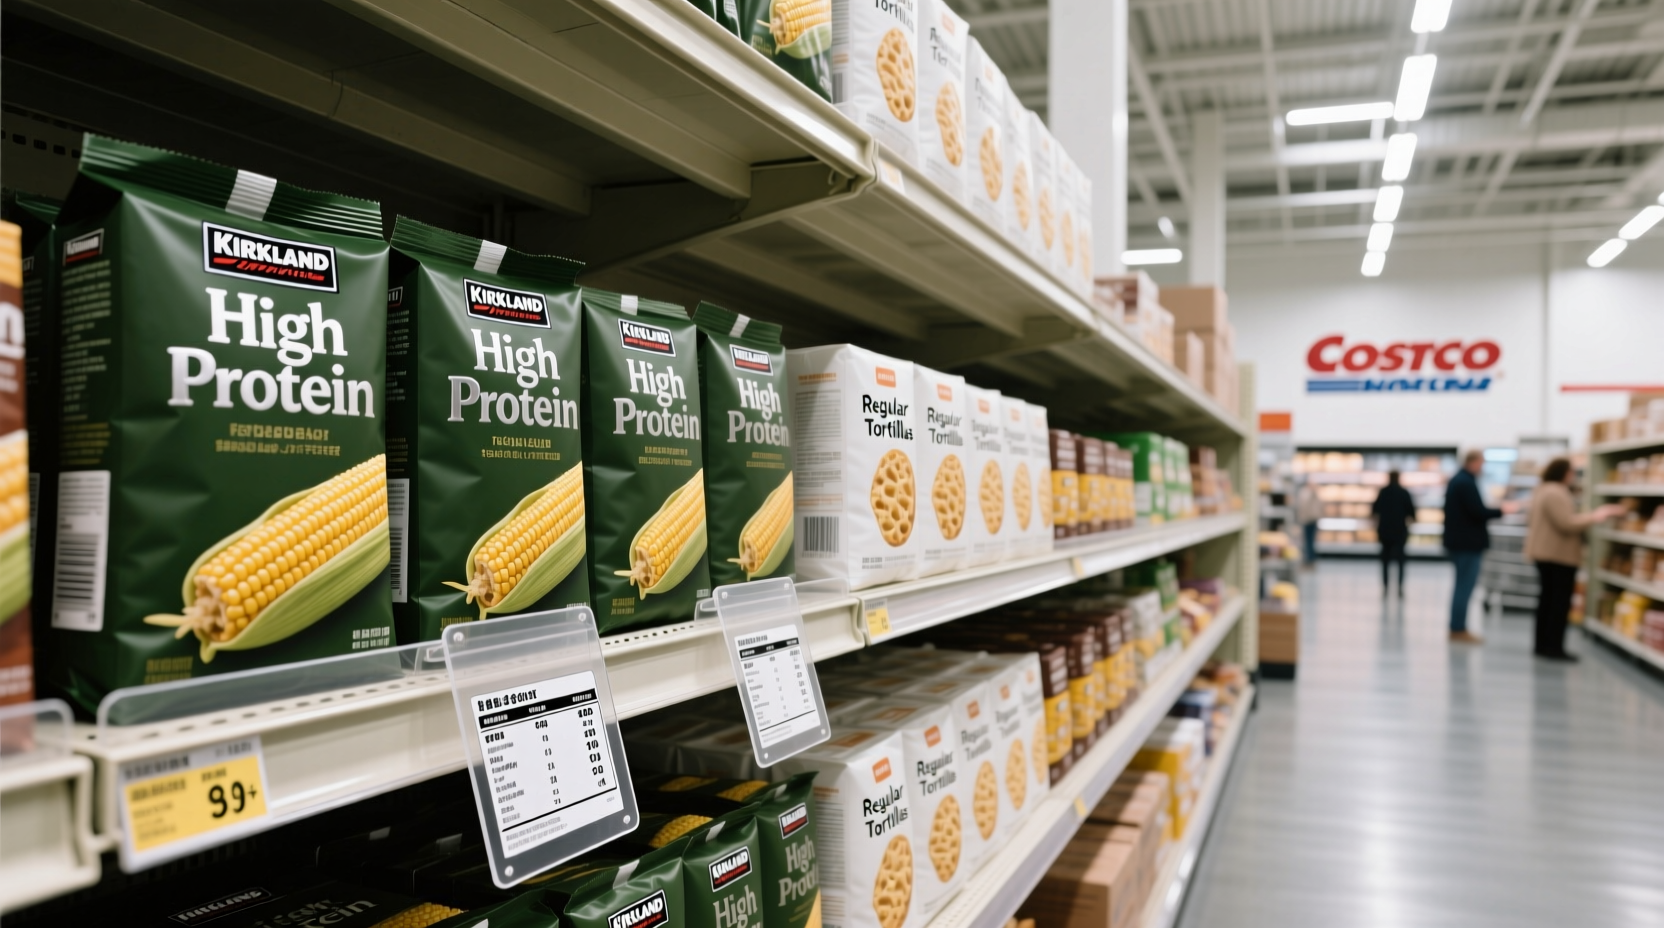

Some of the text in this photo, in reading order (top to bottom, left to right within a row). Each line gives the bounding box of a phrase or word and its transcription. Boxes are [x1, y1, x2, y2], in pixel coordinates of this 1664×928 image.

[213, 230, 330, 272] KIRKLAND
[205, 286, 348, 367] High
[471, 328, 560, 388] High
[167, 346, 376, 419] Protein
[447, 375, 579, 430] Protein
[626, 359, 687, 407] High
[737, 377, 782, 421] High
[613, 397, 700, 440] Protein
[862, 394, 909, 418] Regular
[727, 410, 790, 447] Protein
[863, 785, 904, 817] Regular
[713, 884, 758, 928] High
